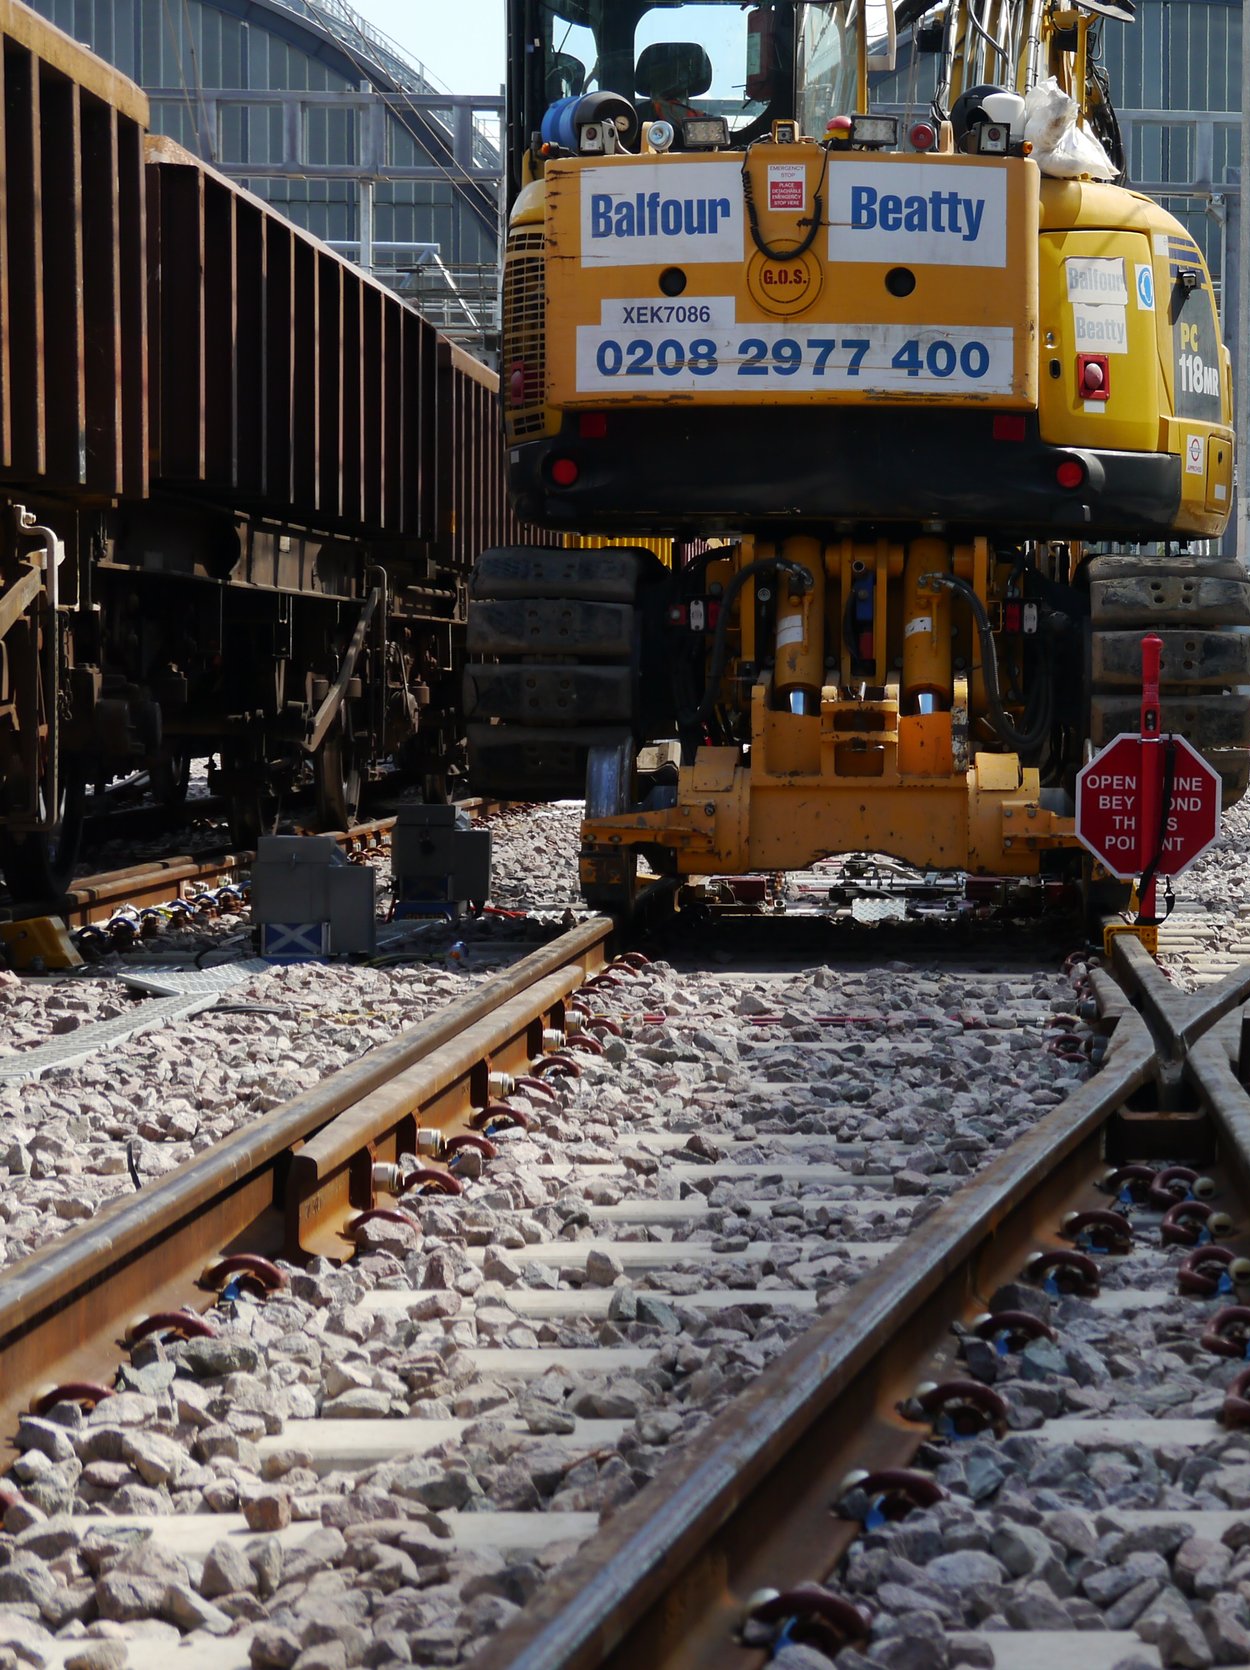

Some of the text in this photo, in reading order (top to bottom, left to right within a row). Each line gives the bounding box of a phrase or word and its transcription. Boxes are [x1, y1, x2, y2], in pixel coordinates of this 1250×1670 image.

[591, 185, 986, 242] Balfour Beatty
[762, 267, 807, 286] G.O.S.
[1068, 267, 1124, 291] Balfour
[622, 305, 711, 325] XEK7086
[1075, 316, 1125, 346] Beatty
[1180, 322, 1199, 353] PC
[596, 338, 990, 379] 0208 2977 400
[1086, 775, 1203, 792] OPEN INE
